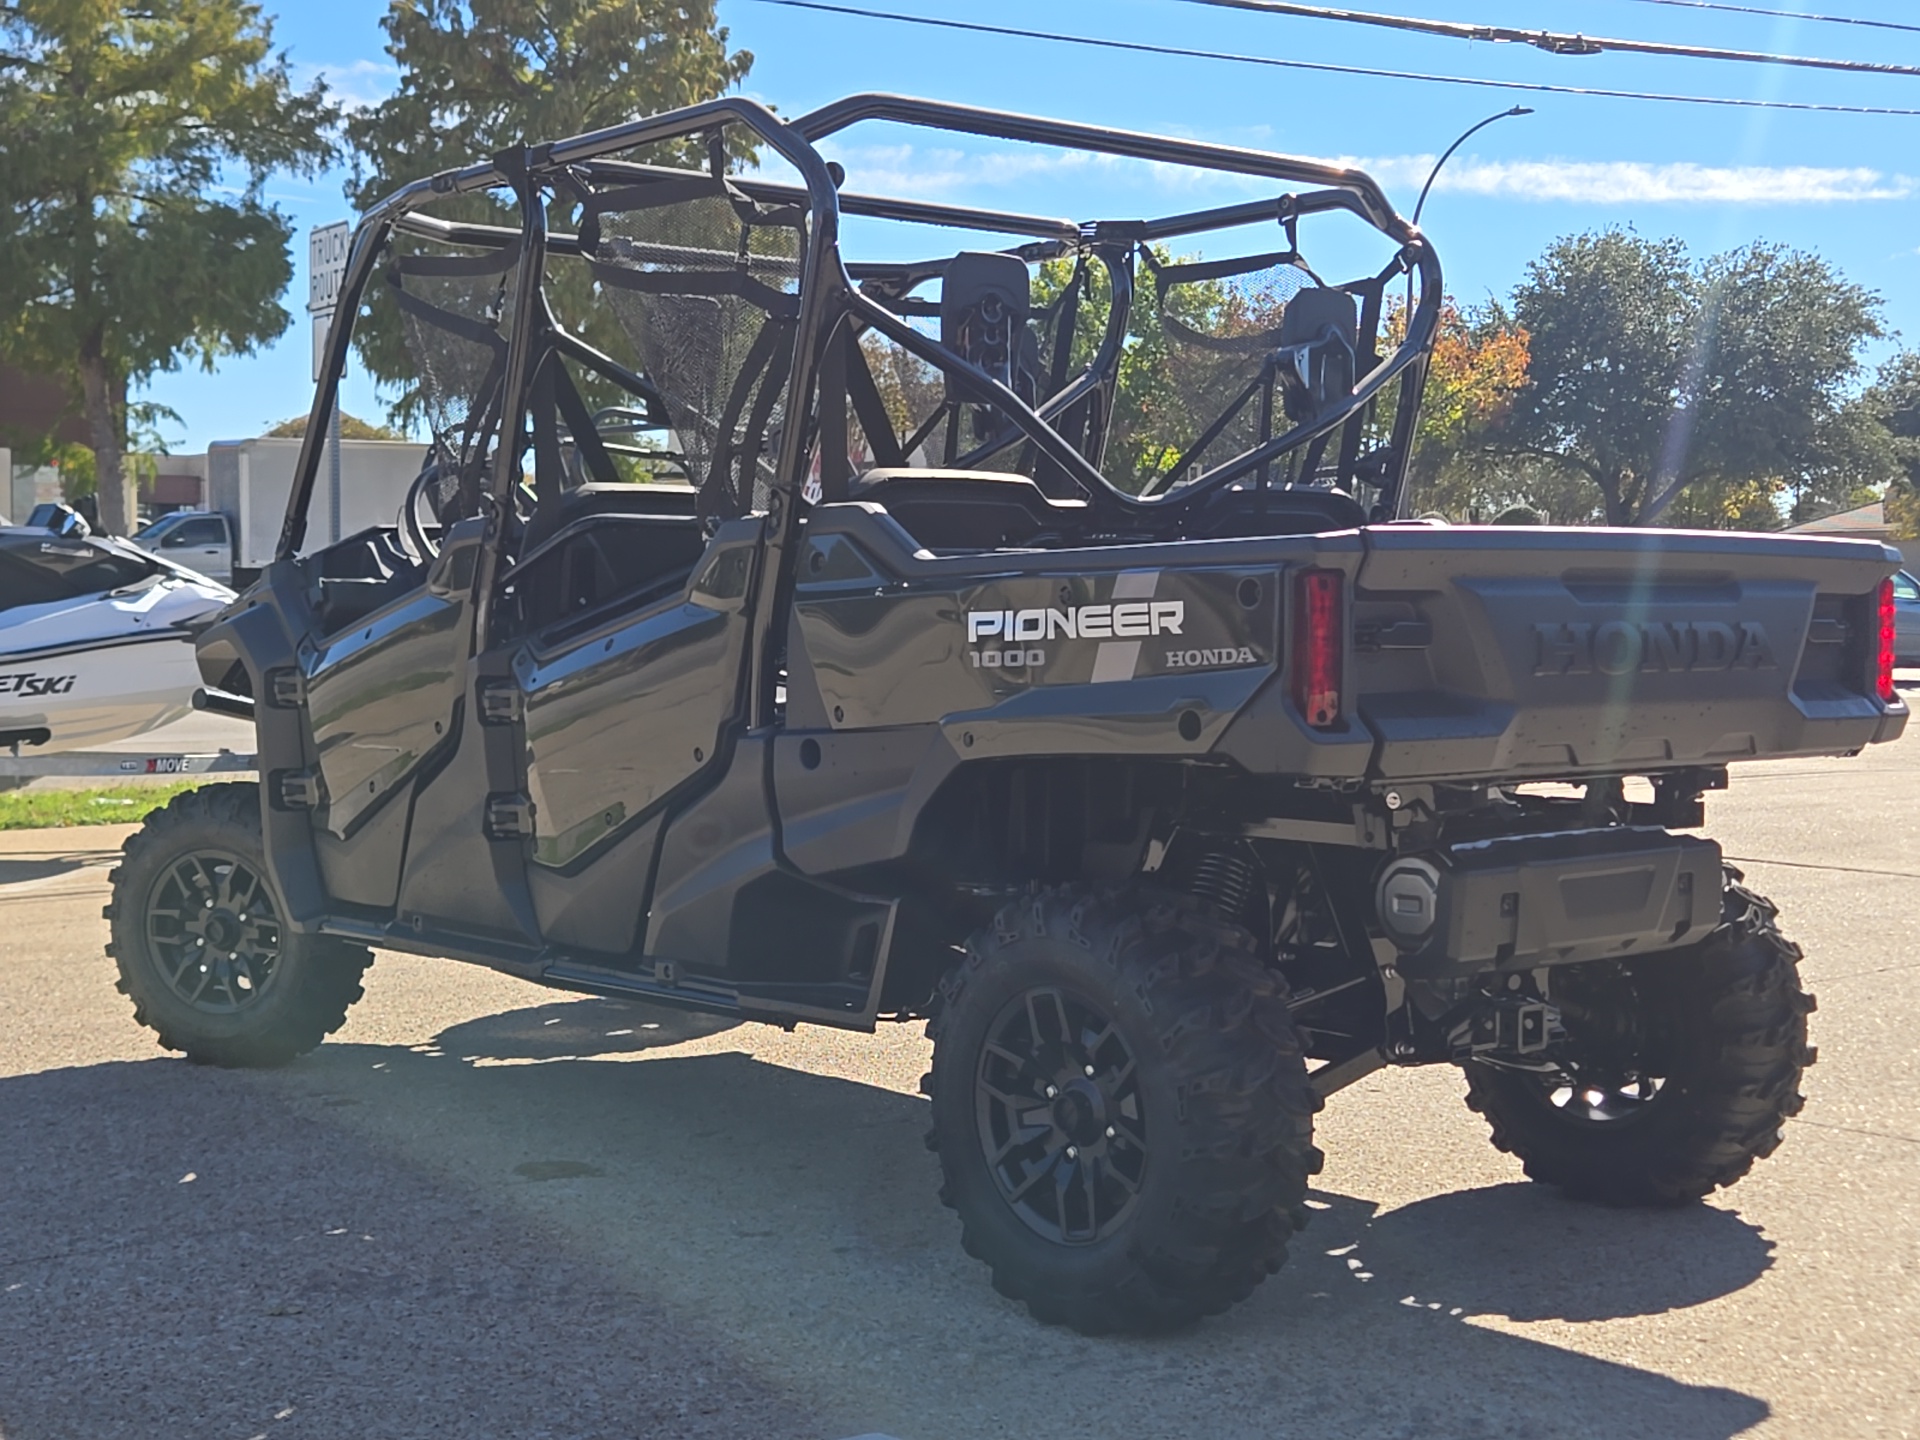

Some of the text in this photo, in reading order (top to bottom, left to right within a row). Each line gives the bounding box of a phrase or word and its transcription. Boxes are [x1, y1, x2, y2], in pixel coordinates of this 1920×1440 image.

[312, 231, 346, 268] TRUCK
[967, 600, 1184, 643] PIONEER
[969, 649, 1045, 668] 1000
[1165, 647, 1256, 668] HONDA
[1530, 620, 1780, 677] HONDA
